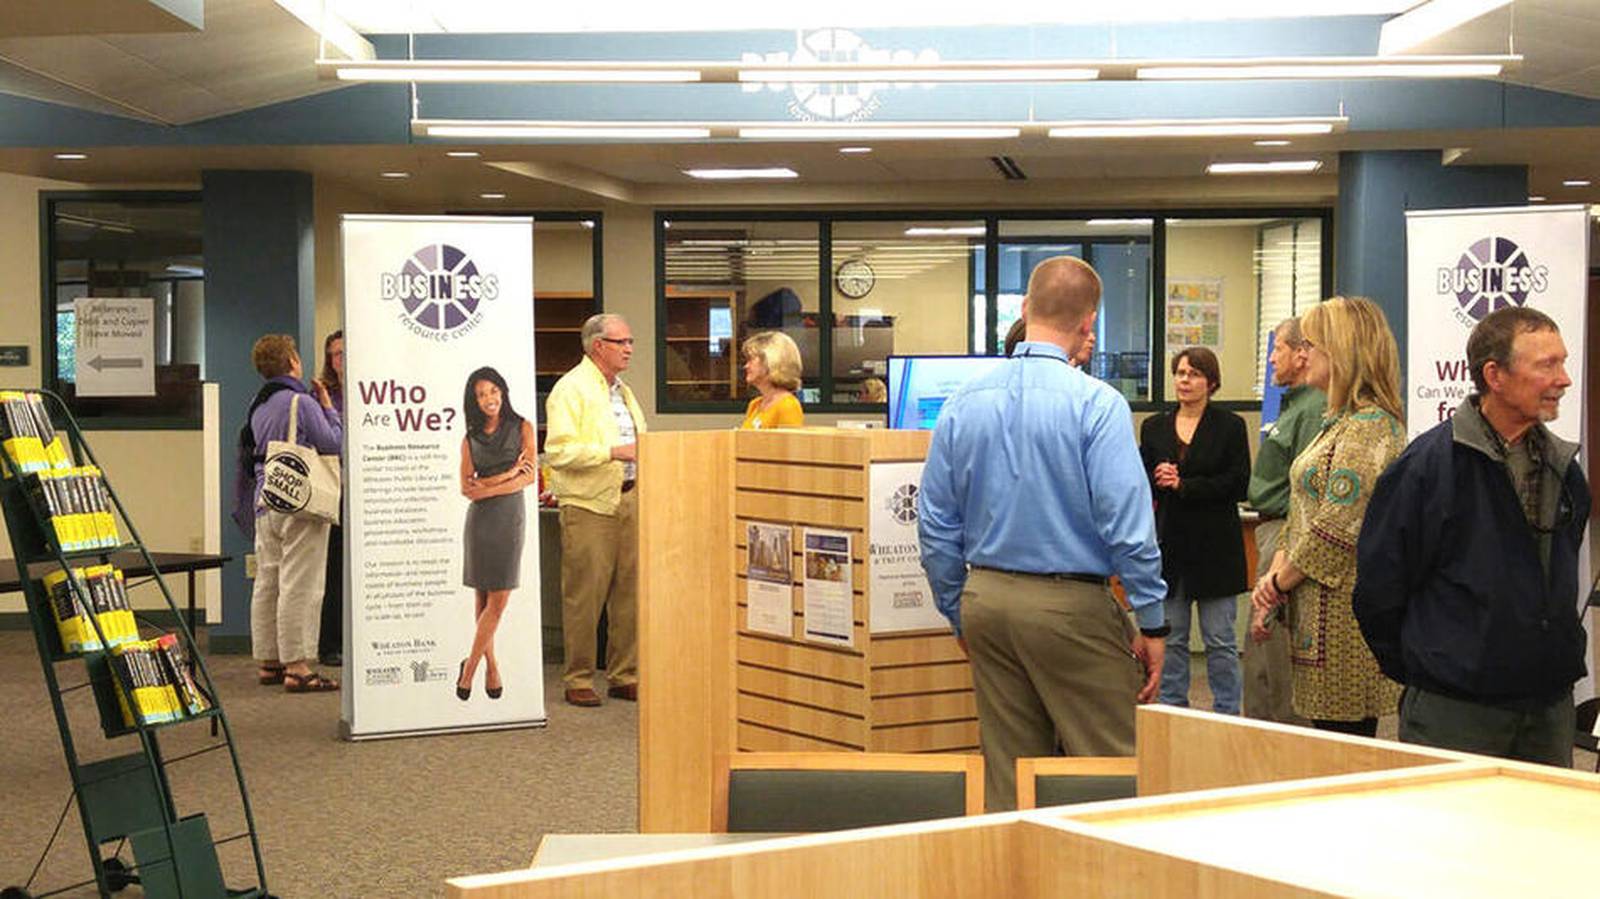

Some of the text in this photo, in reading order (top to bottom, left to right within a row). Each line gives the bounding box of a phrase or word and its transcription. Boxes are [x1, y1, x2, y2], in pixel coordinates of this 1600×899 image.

[381, 272, 499, 301] BUSINESS
[1436, 265, 1549, 295] BUSINESS
[398, 311, 484, 342] resource center
[359, 379, 427, 405] Who
[1417, 386, 1466, 399] Can We
[362, 407, 456, 432] Are We?
[267, 476, 300, 501] SMALL
[272, 466, 302, 487] SHOP
[870, 544, 919, 556] WHEATON
